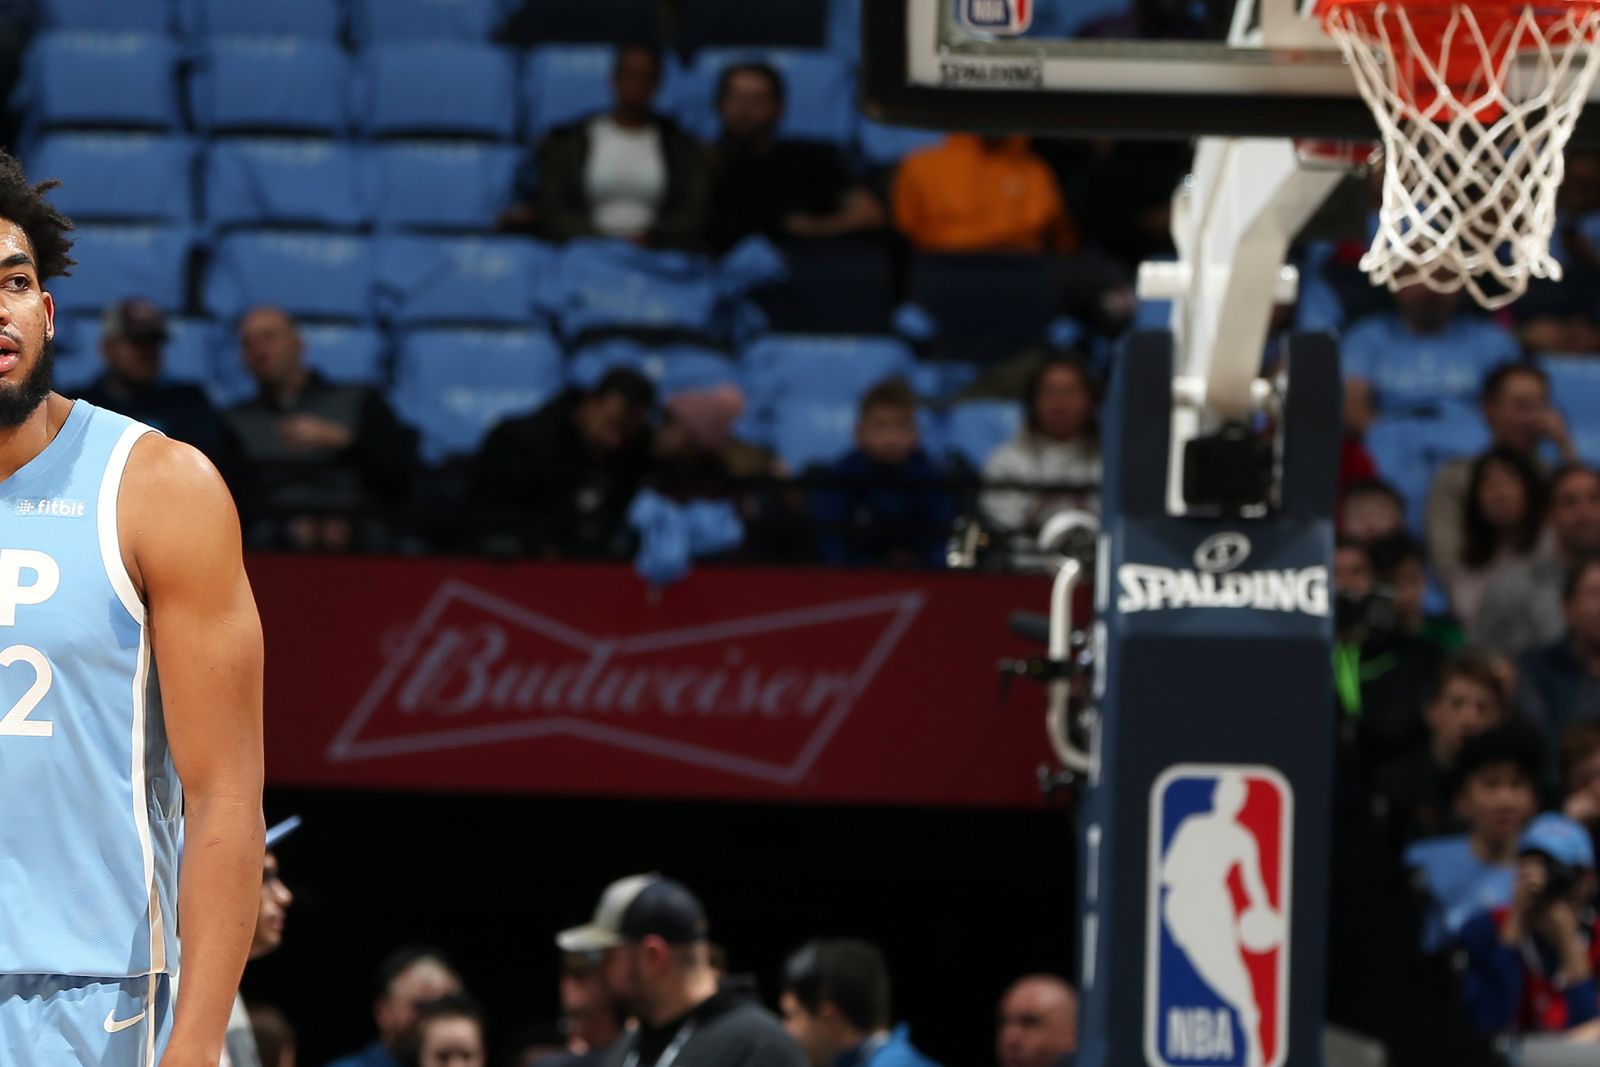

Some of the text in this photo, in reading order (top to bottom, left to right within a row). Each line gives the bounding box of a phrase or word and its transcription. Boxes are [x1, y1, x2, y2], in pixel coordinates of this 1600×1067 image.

[38, 499, 85, 516] fitbit
[1117, 562, 1329, 617] SPALDING
[382, 622, 860, 718] Budweiser
[1167, 1006, 1234, 1060] NBA
